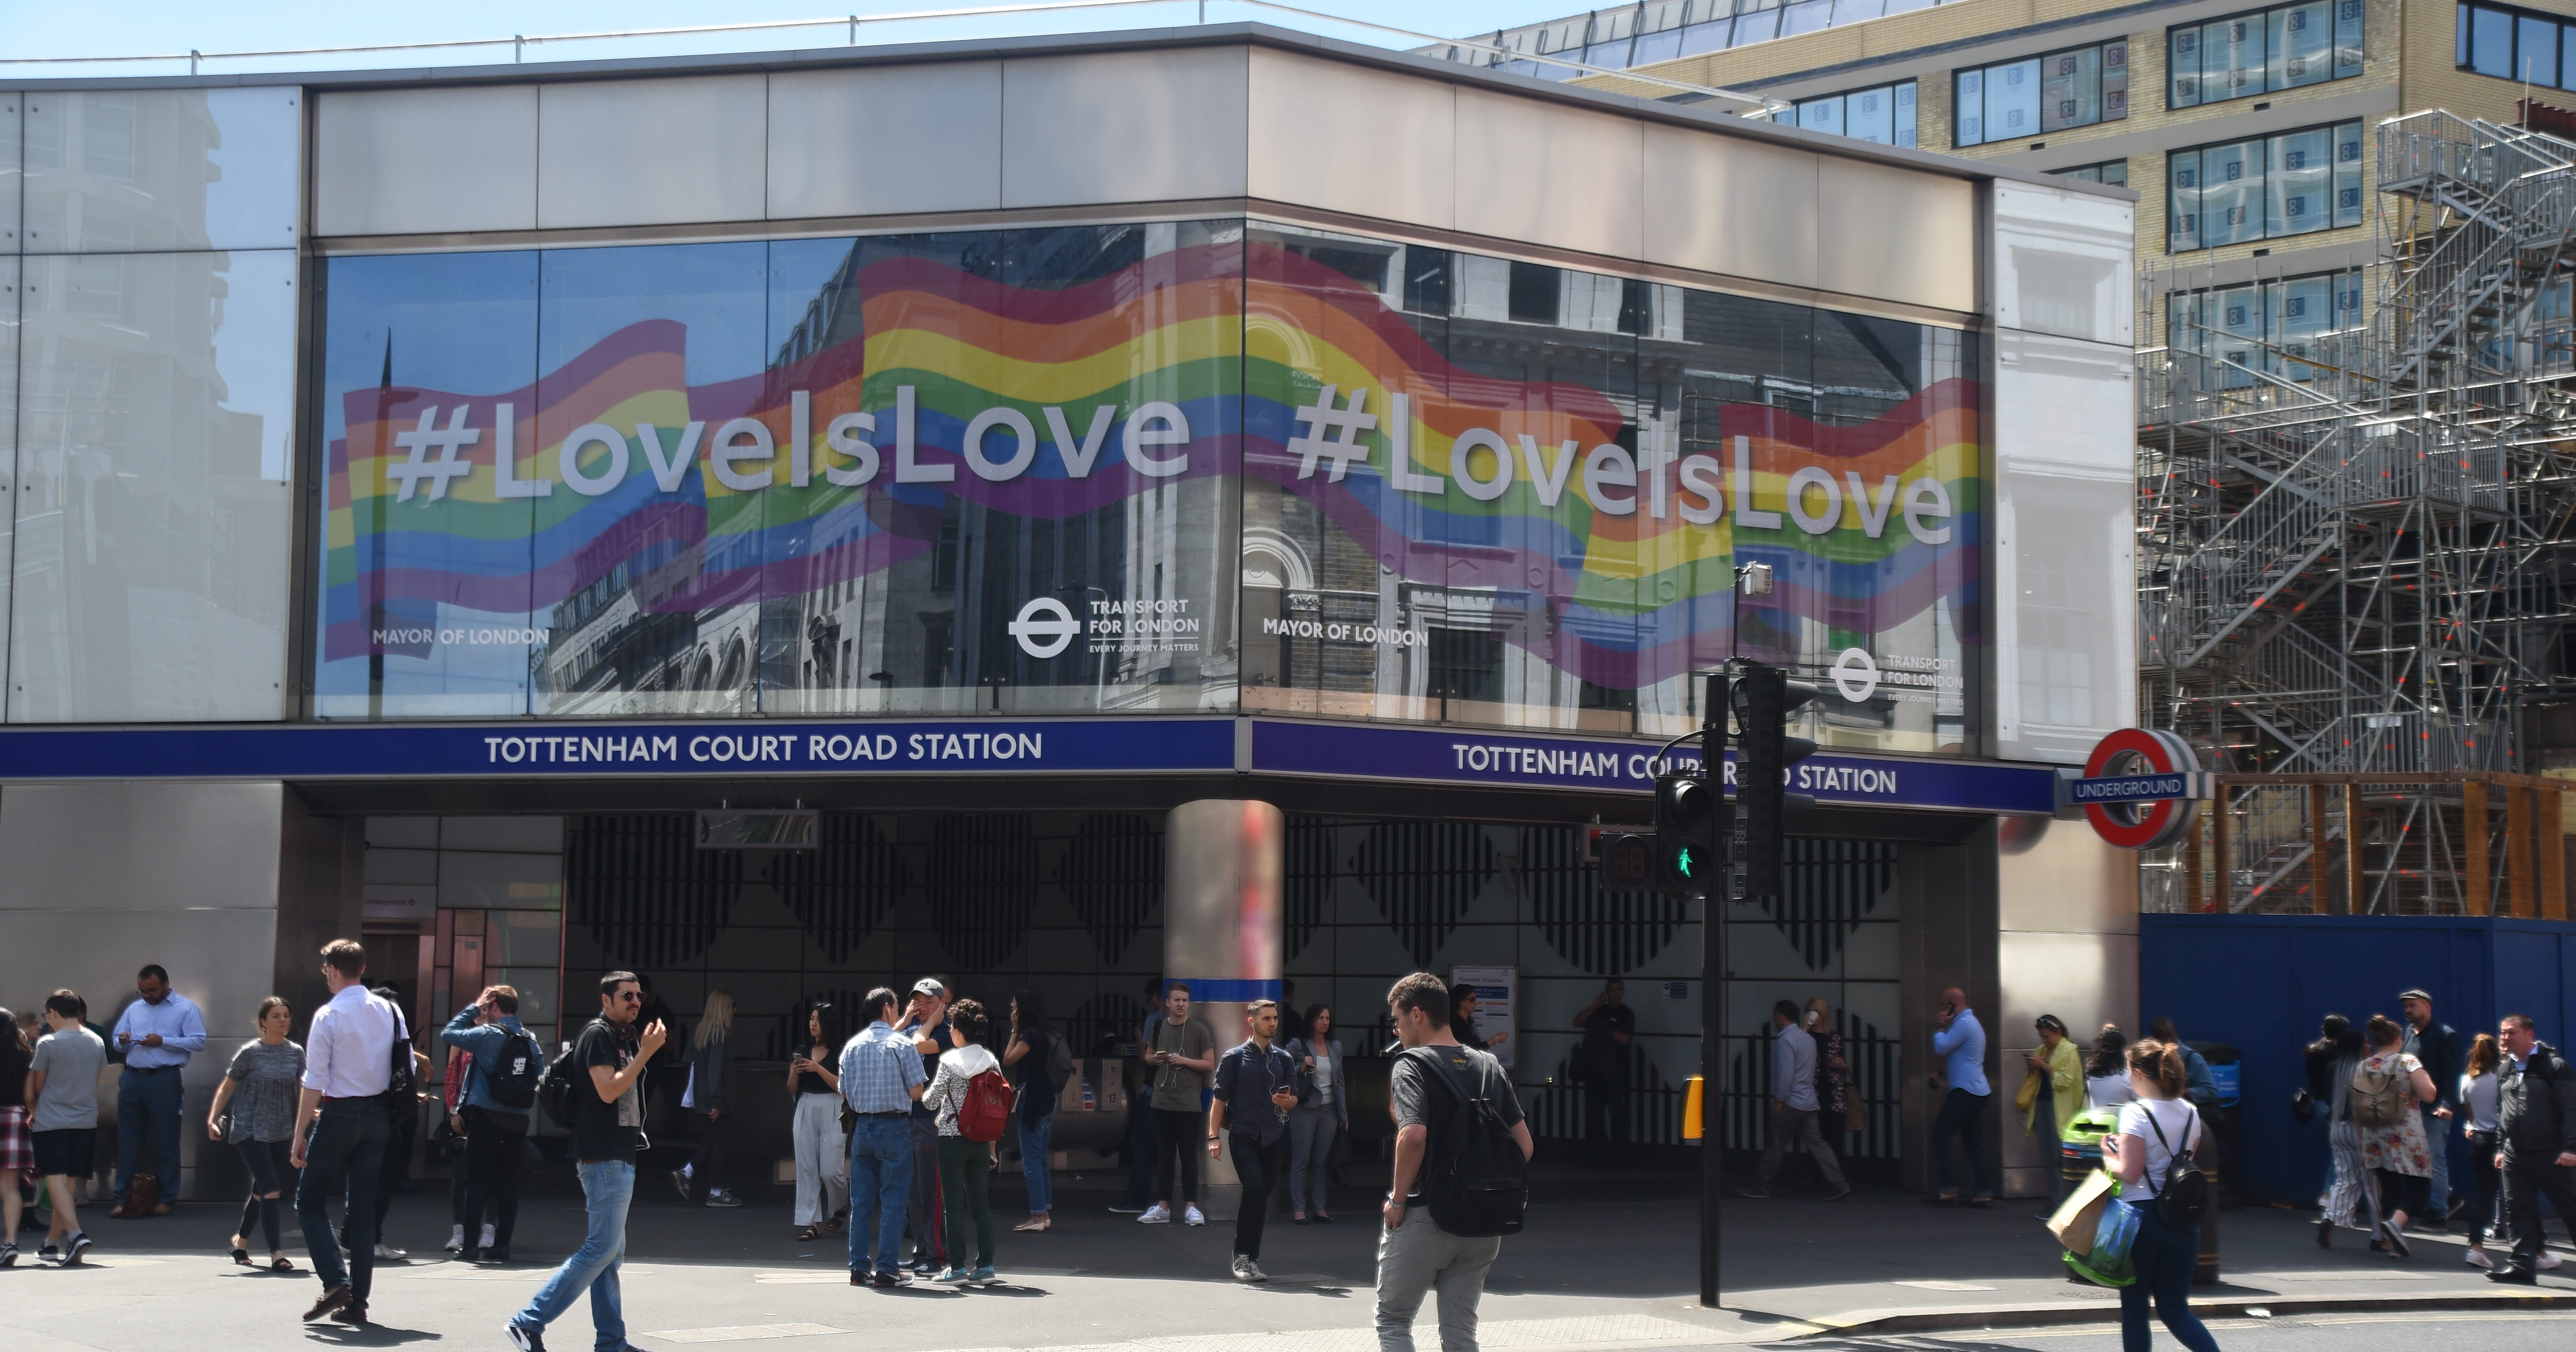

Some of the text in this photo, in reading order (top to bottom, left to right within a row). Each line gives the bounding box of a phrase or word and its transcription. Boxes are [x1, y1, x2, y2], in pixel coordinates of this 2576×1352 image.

[386, 385, 1190, 503] #LoveIsLove
[1287, 384, 1951, 545] #LoveIsLove
[1091, 599, 1189, 615] TRANSPORT
[1090, 619, 1199, 634] FOR LONDON
[1264, 618, 1428, 647] MAYOR OF LONDON
[373, 628, 550, 645] MAYOR OF LONDON
[1090, 643, 1199, 653] EVERY JOURNEY MATTERS
[1888, 655, 1956, 671] TRANSPORT
[1888, 672, 1963, 688] FOR LONDON
[1888, 694, 1906, 702] EVERY
[1908, 695, 1935, 704] JOURNEY
[485, 733, 1042, 763] TOTTENHAM COURT ROAD STATION
[1453, 744, 1619, 778] TOTTENHAM
[1798, 765, 1896, 795] STATION
[2077, 779, 2182, 798] UNDERGROUND
[1109, 1094, 1116, 1103] 13
